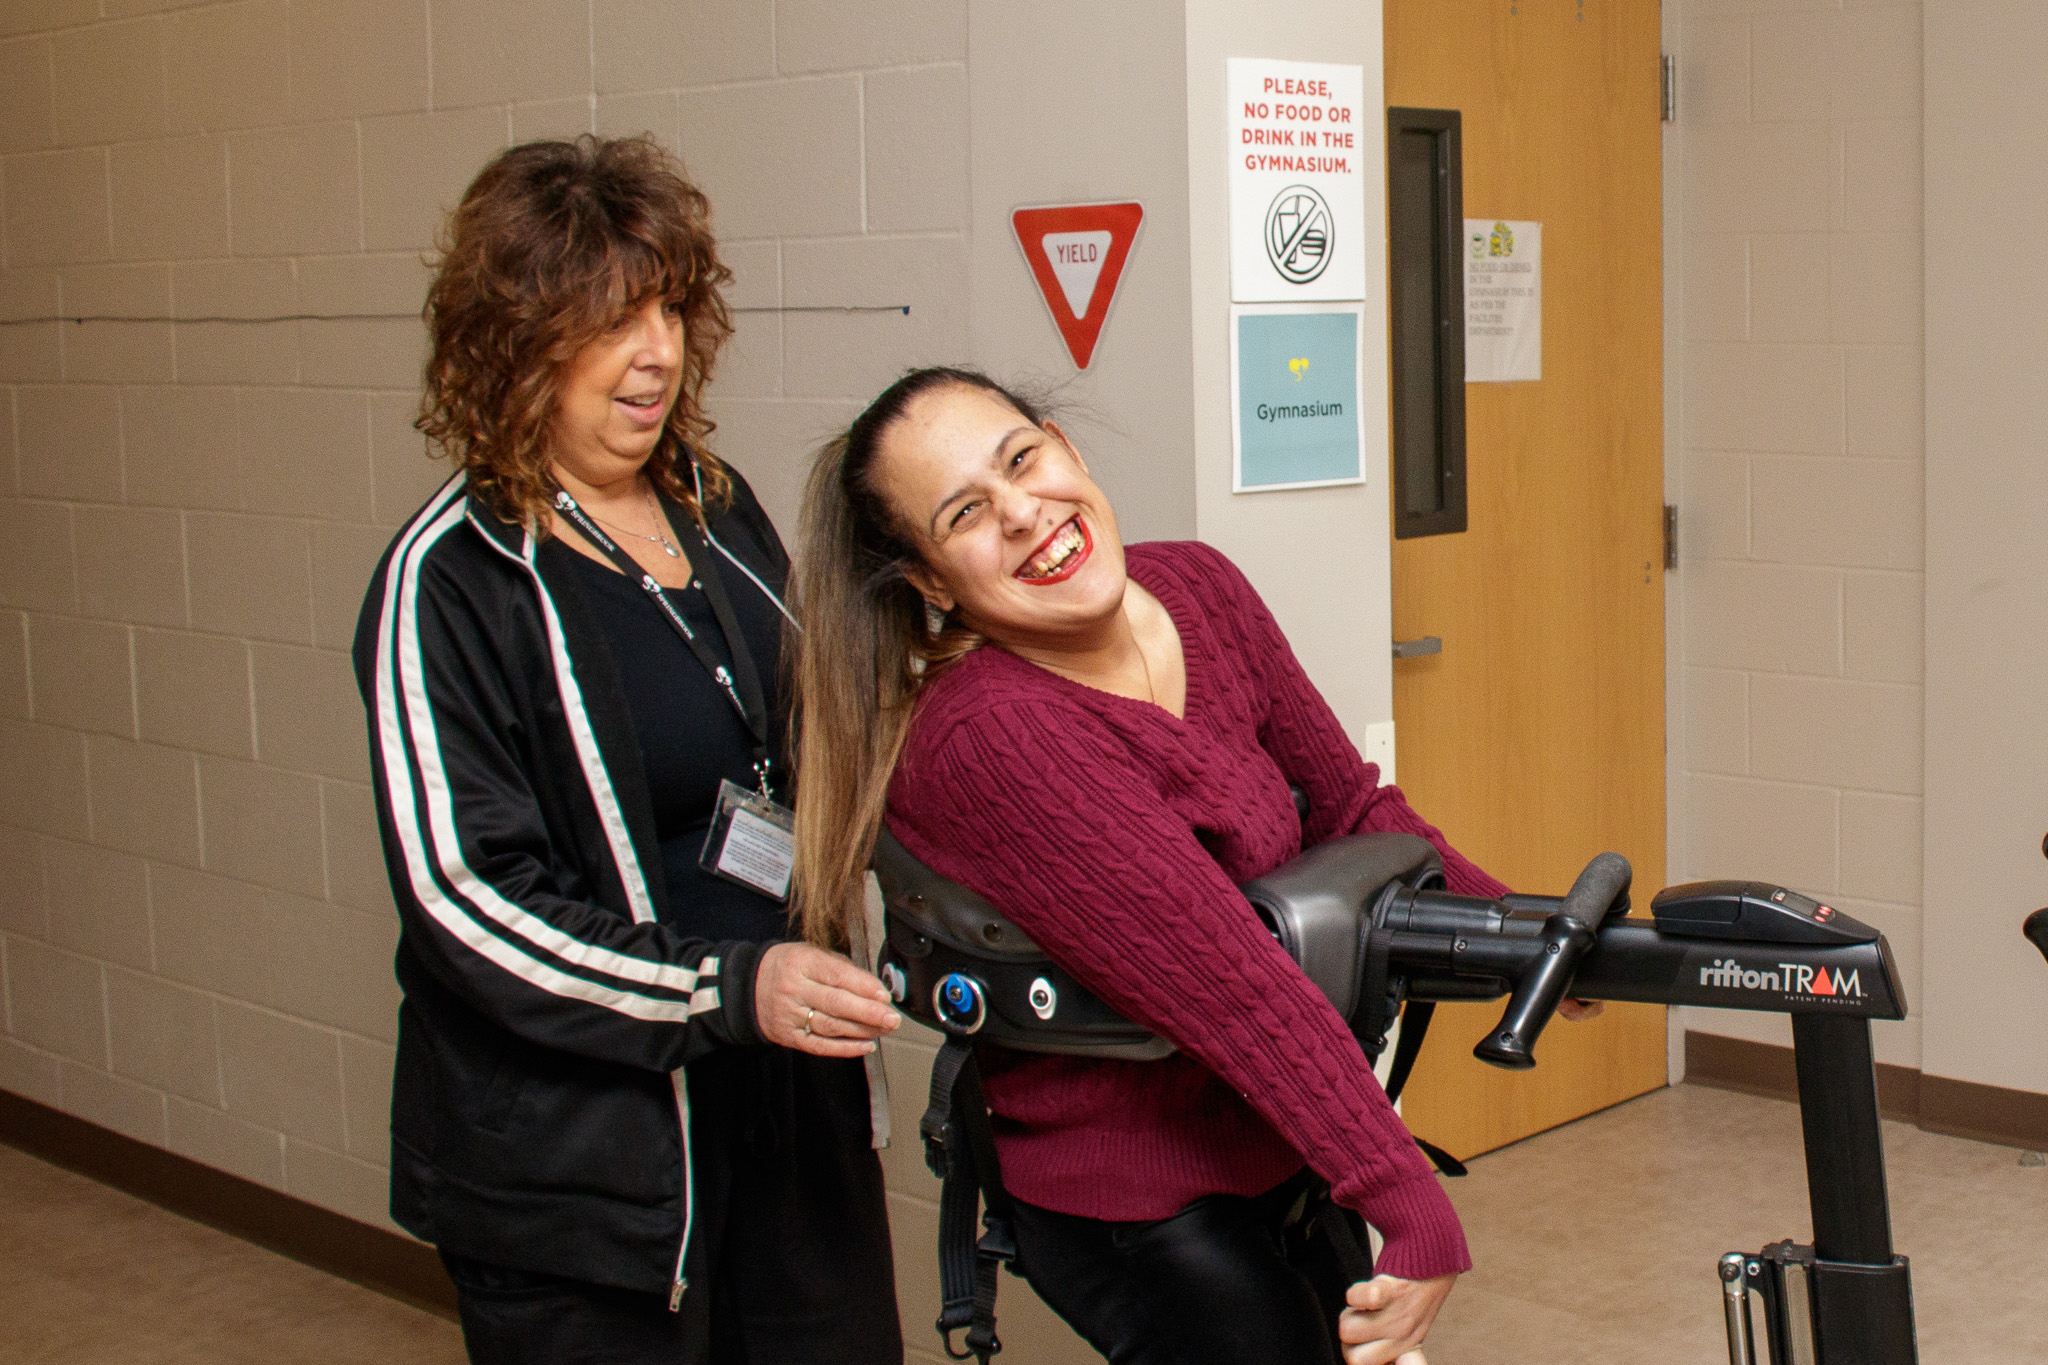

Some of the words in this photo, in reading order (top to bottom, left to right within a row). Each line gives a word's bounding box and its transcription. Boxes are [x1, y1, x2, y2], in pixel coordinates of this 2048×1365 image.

[1264, 77, 1332, 99] PLEASE,
[1244, 103, 1269, 119] NO
[1275, 104, 1322, 122] FOOD
[1328, 107, 1351, 123] OR
[1242, 129, 1294, 146] DRINK
[1300, 131, 1317, 147] IN
[1323, 132, 1354, 148] THE
[1245, 154, 1352, 174] GYMNASIUM.
[1057, 243, 1098, 264] YIELD
[1257, 400, 1343, 423] Gymnasium
[570, 509, 616, 552] SPRINGBROOK
[1784, 995, 1816, 1003] PATENT
[1821, 997, 1862, 1006] PENDING
